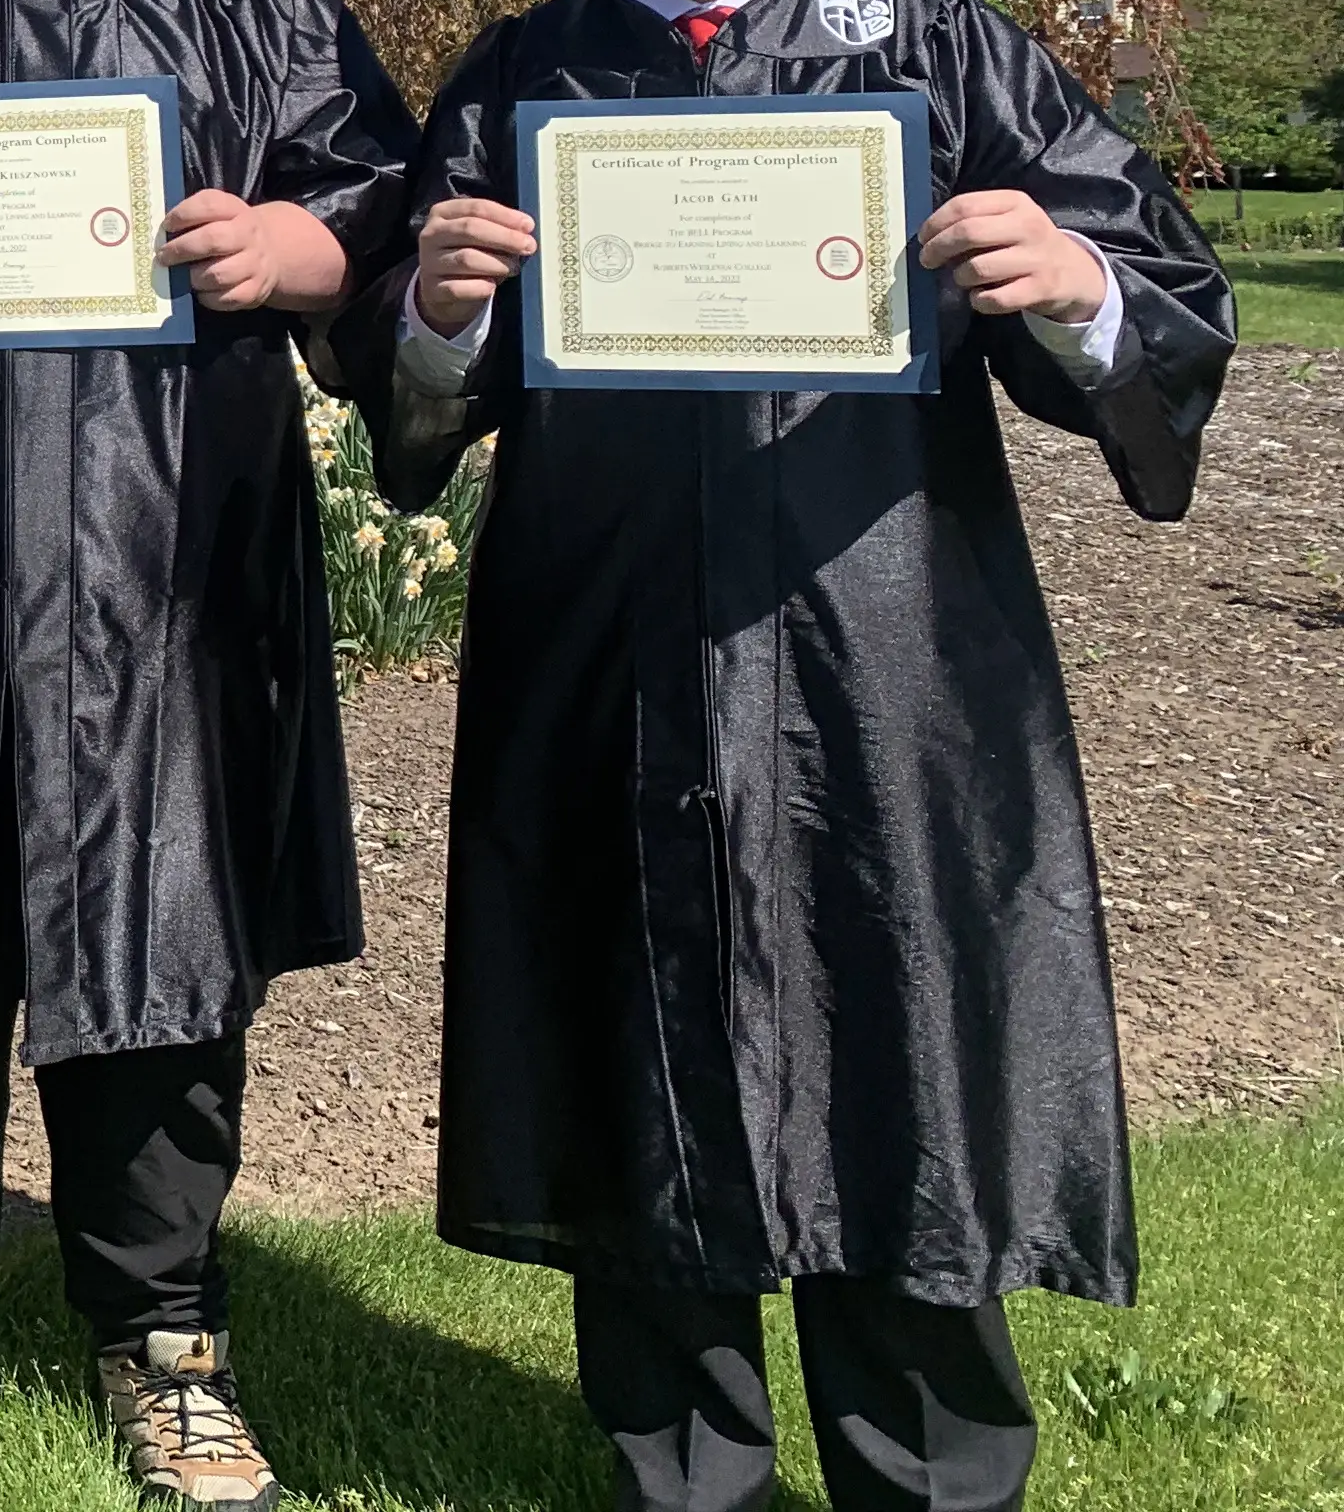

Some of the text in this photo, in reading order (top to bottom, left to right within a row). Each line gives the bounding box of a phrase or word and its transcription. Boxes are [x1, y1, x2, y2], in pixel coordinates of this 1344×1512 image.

[35, 134, 107, 148] Completion
[591, 153, 838, 170] Certificate of Program Completion
[673, 193, 758, 205] JACOB GATH
